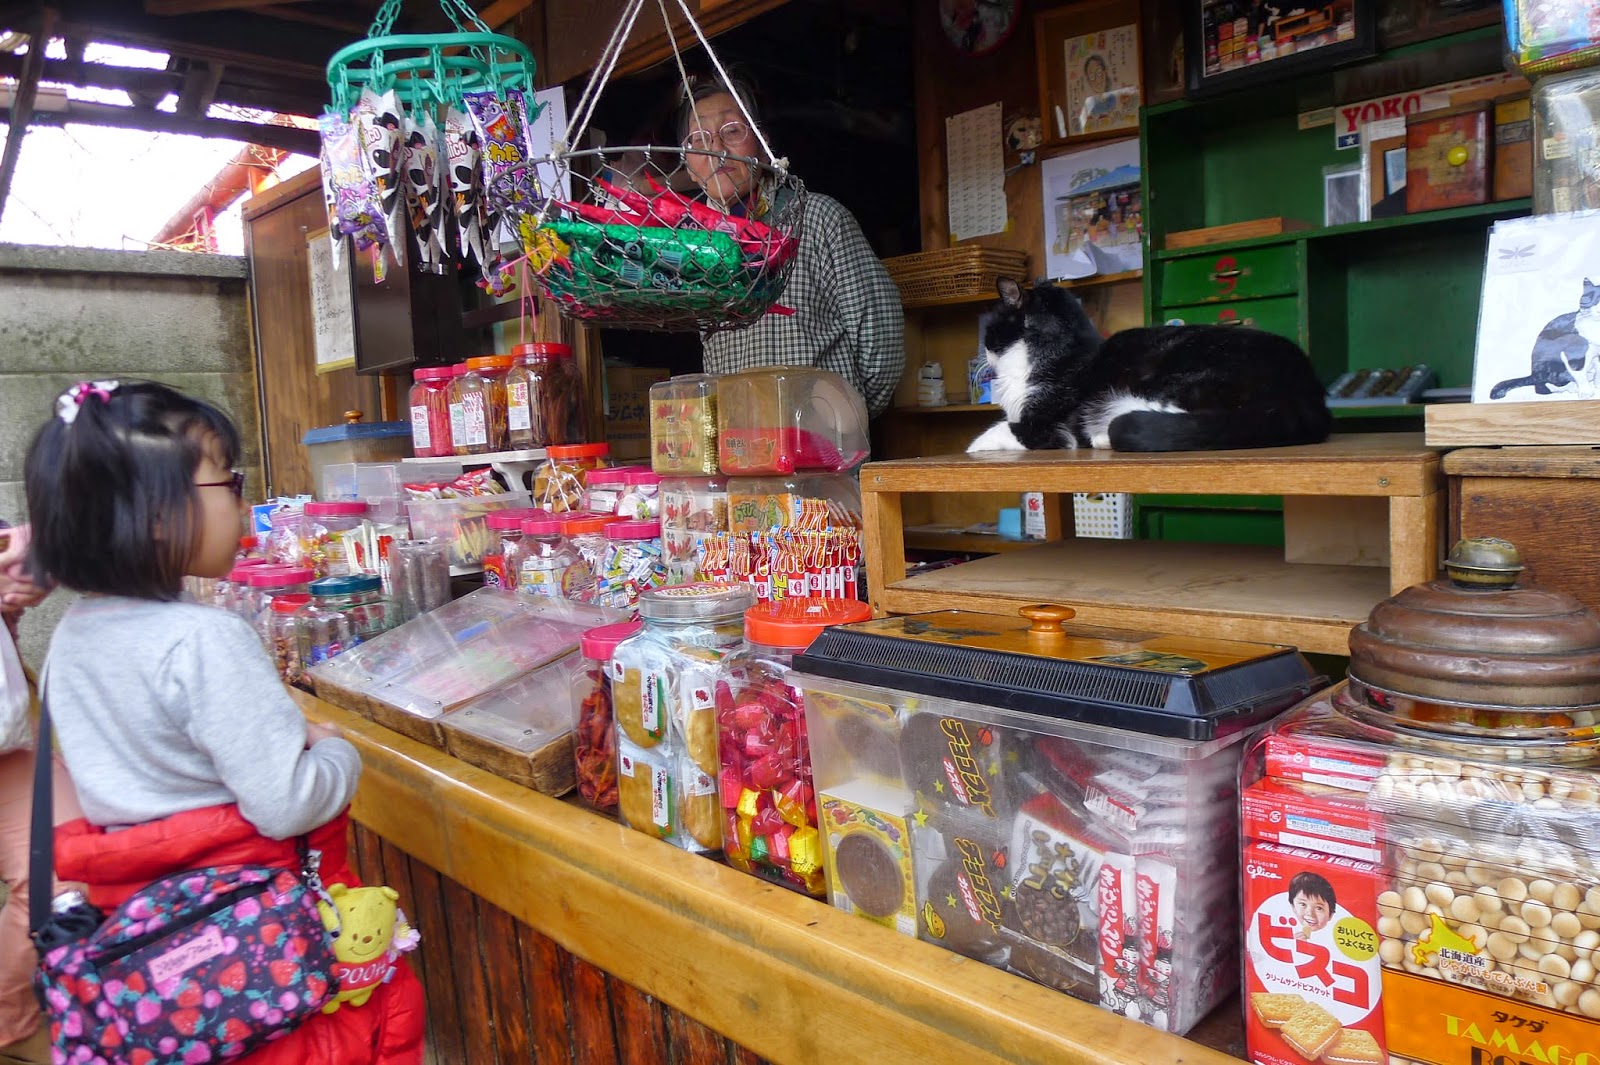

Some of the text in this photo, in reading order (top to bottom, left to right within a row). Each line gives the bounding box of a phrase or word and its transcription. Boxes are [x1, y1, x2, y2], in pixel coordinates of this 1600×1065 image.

[944, 760, 968, 806] カステラ
[1246, 864, 1283, 880] Glico
[958, 875, 981, 924] カステラ
[1337, 926, 1375, 941] おいしくて
[1338, 937, 1375, 953] つよくなる
[1258, 912, 1370, 1011] ビスコ
[1439, 947, 1486, 967] 北海道産
[1265, 972, 1331, 998] クリームサンドビスケット
[1491, 1010, 1549, 1033] タケダ
